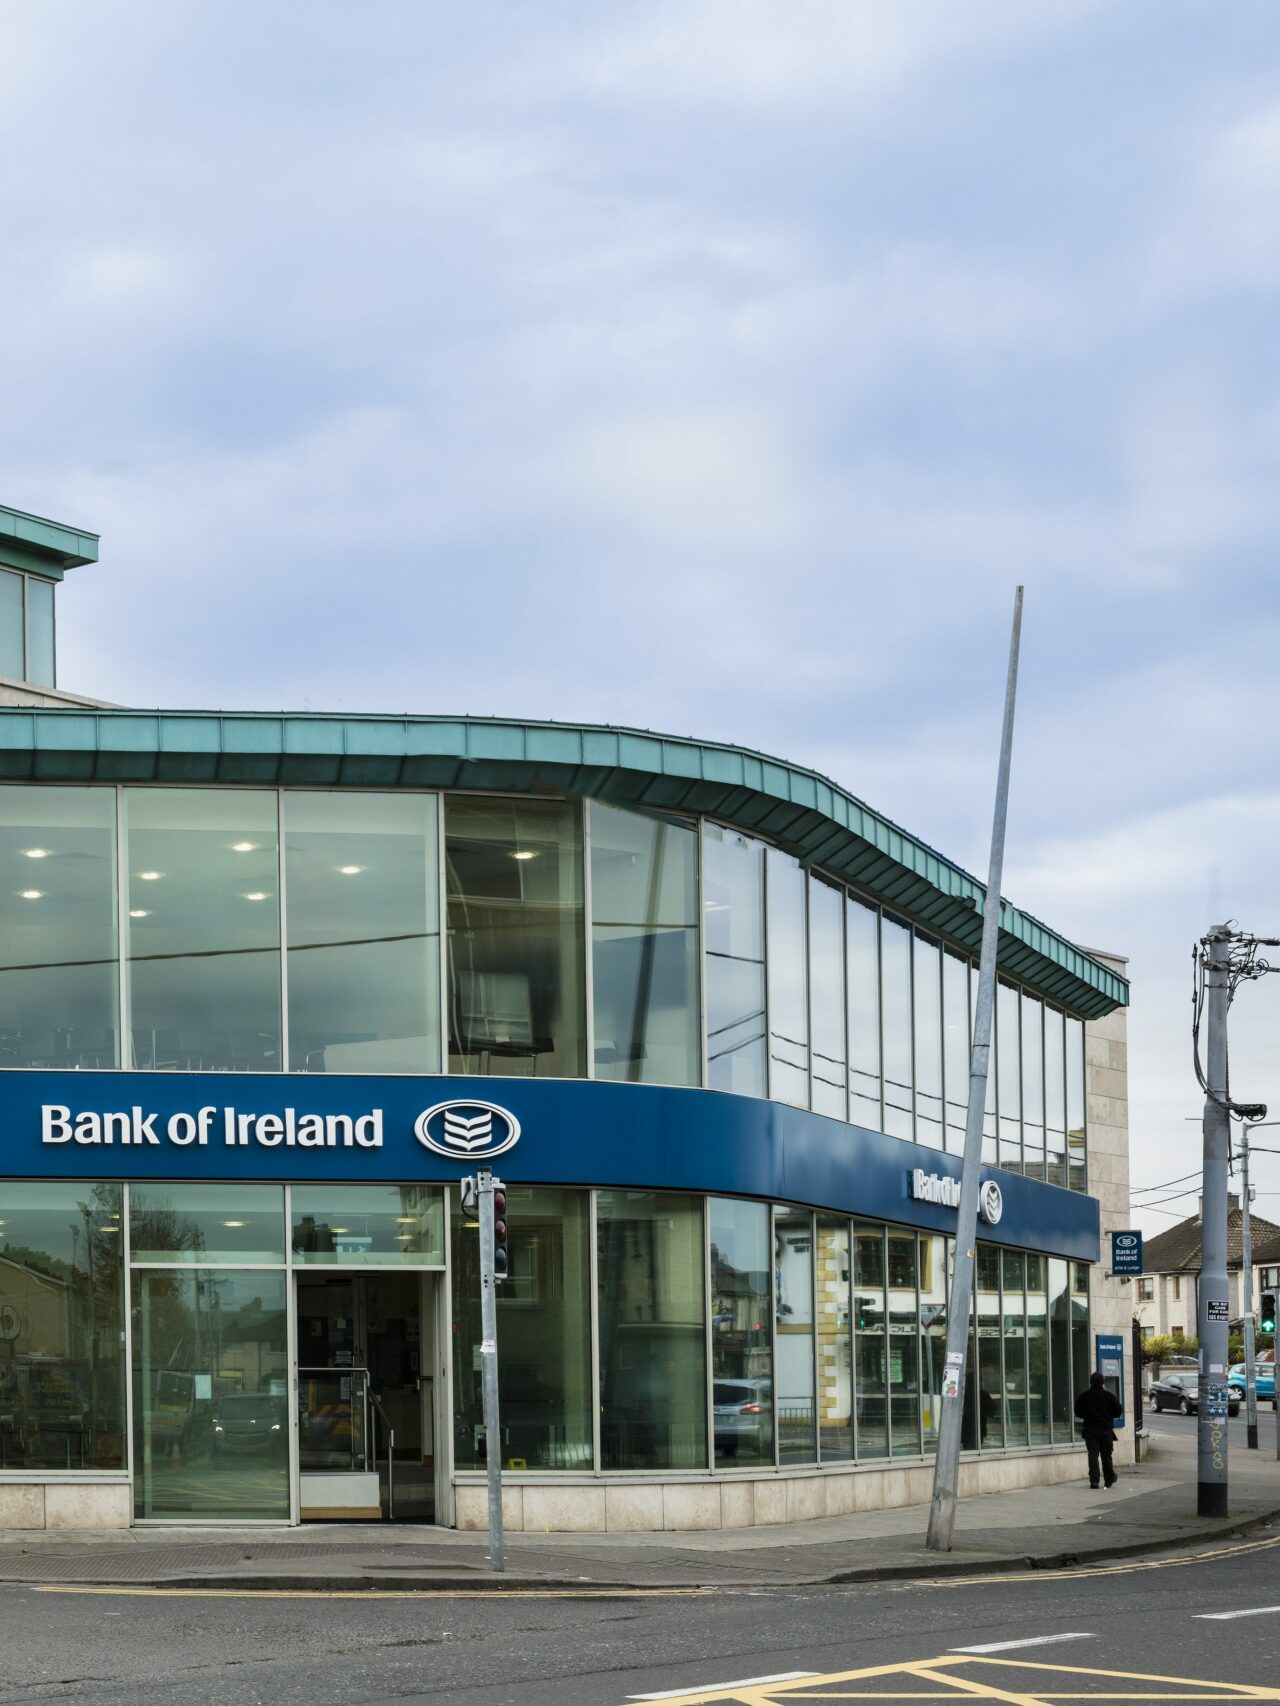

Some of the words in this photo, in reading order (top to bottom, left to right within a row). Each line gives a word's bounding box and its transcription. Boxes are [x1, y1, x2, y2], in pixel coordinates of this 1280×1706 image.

[41, 1104, 160, 1145] Bank
[167, 1106, 217, 1146] of
[224, 1107, 384, 1147] Ireland
